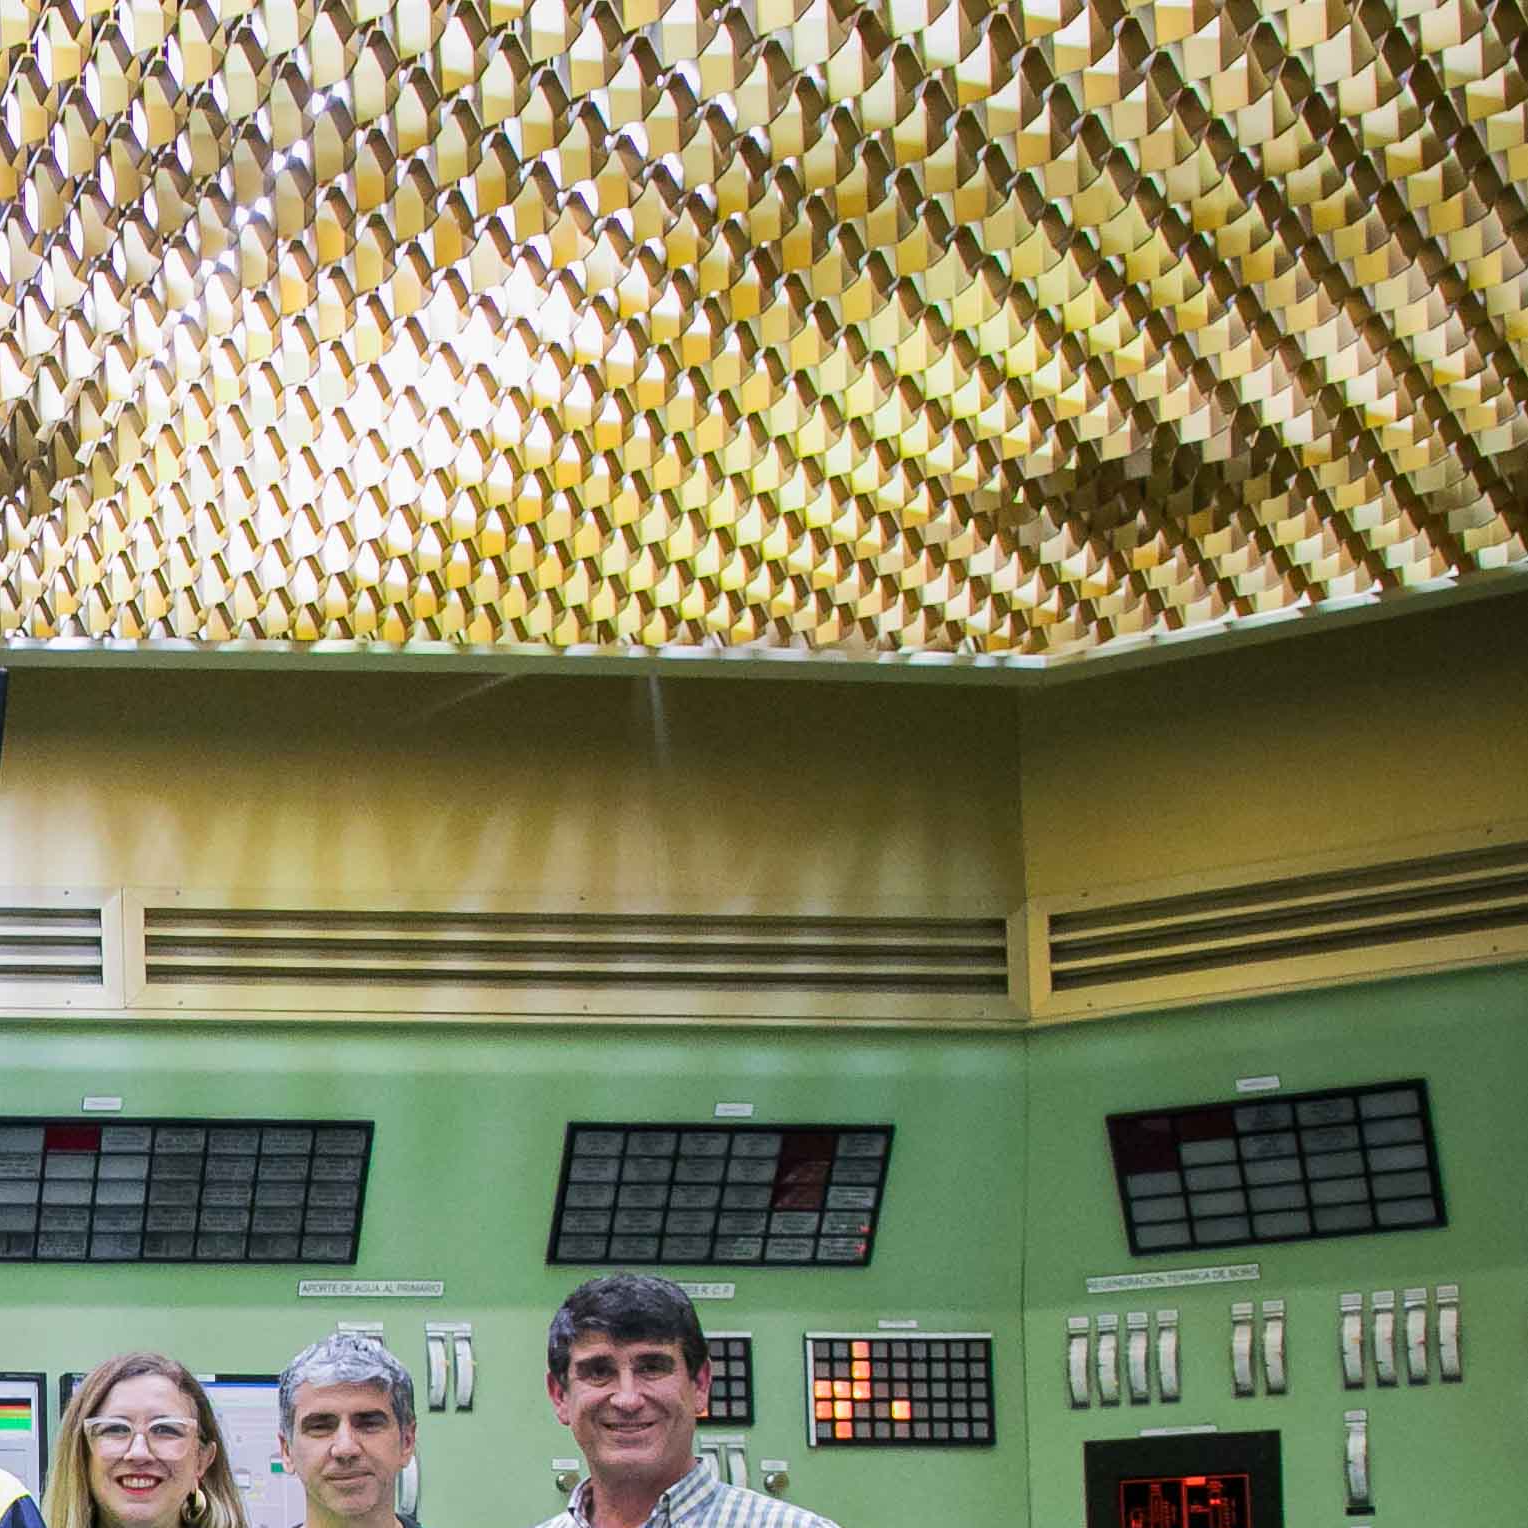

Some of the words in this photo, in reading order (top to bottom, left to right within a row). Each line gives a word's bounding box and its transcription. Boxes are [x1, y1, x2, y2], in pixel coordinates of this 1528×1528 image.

[302, 1283, 337, 1293] APORTE
[340, 1283, 353, 1293] DE
[355, 1283, 380, 1293] AGUA
[396, 1283, 441, 1294] PRIMARIO
